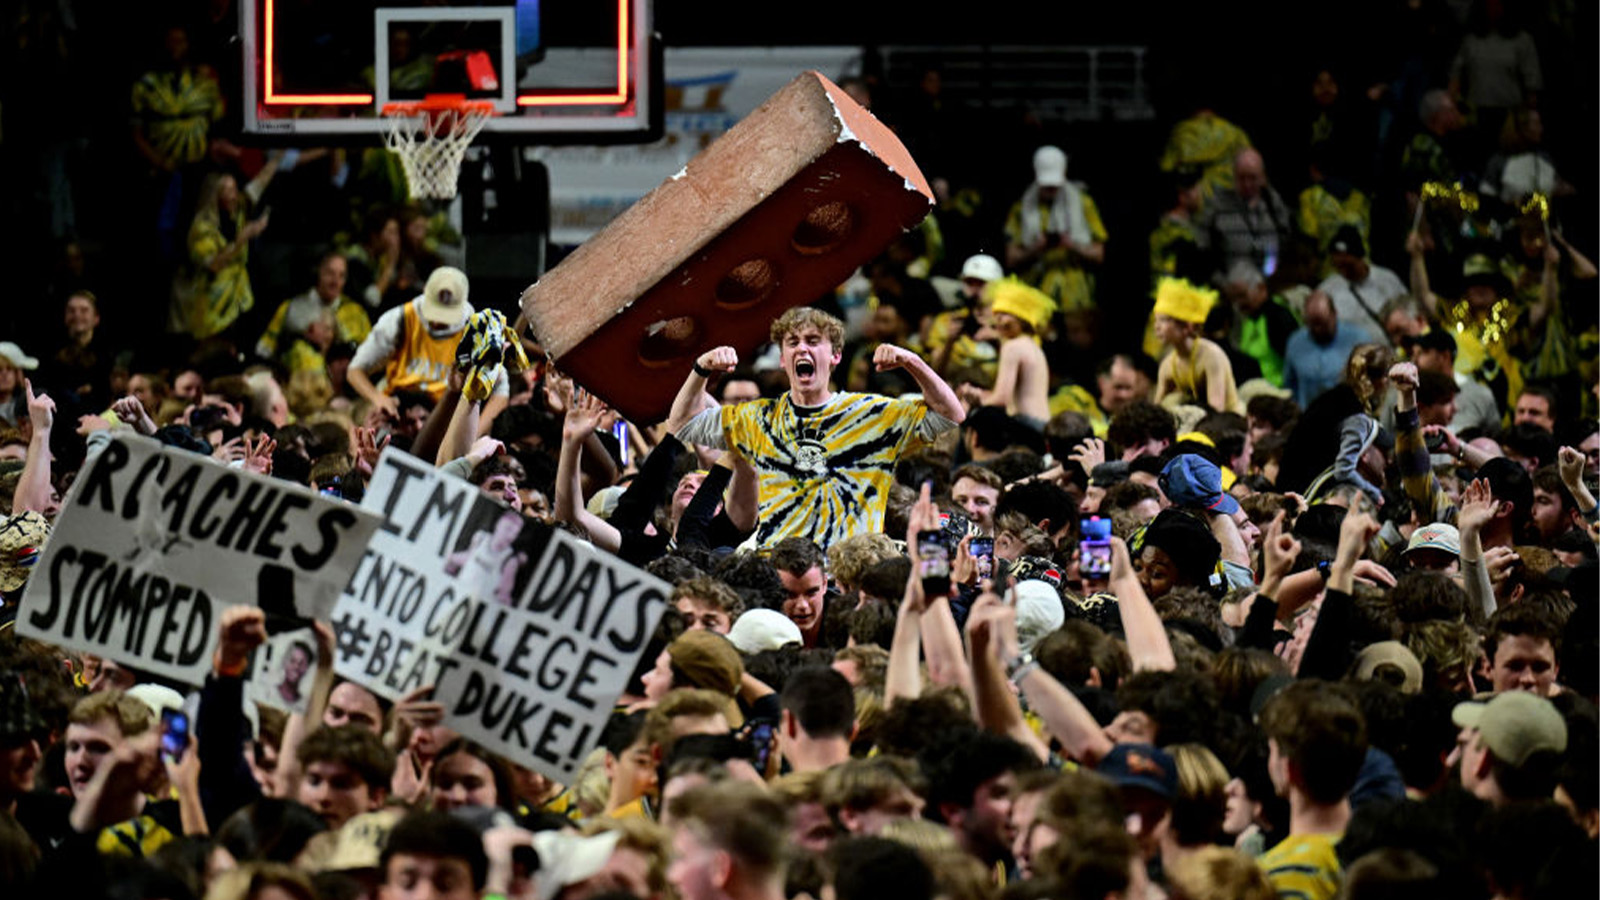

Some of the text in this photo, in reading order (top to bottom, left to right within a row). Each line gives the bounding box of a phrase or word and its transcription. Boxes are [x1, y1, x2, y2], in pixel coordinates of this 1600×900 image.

[29, 545, 213, 667] STOMPED
[344, 549, 619, 710] INTO COLLEGE
[526, 540, 665, 654] DAYS
[331, 612, 593, 773] #BEAT DUKE!
